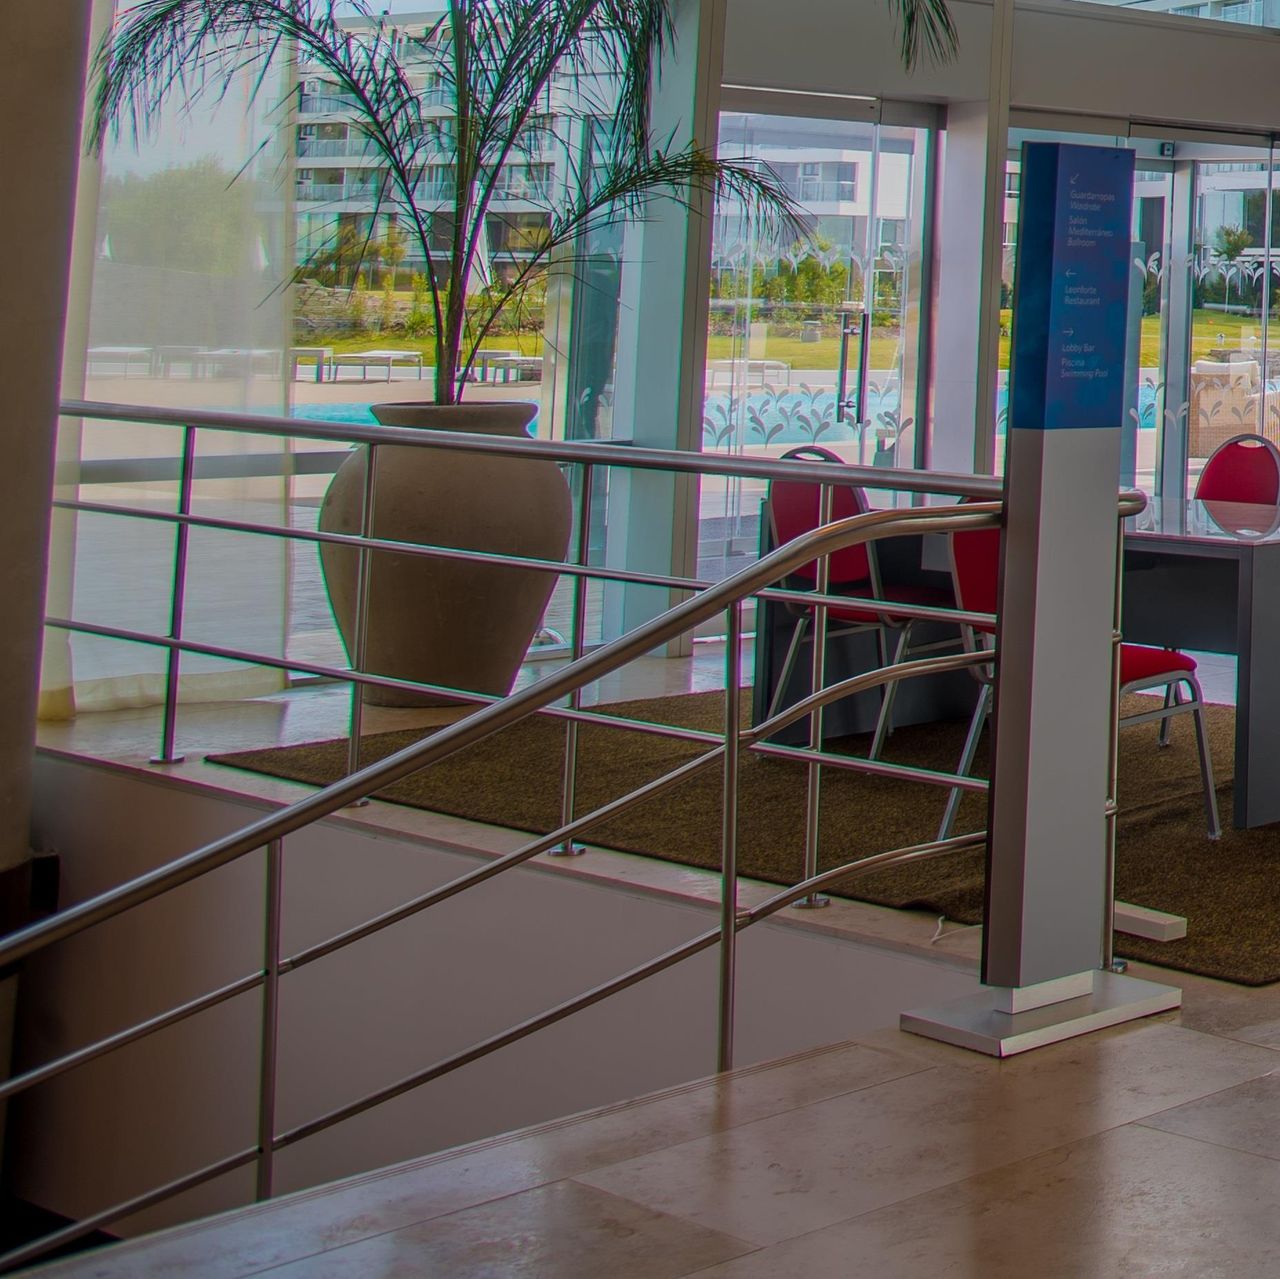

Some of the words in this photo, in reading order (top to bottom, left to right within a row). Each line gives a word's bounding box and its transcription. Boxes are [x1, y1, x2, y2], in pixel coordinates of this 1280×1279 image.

[1064, 295, 1100, 305] Restaurant
[1062, 343, 1082, 354] Lobby
[1083, 343, 1095, 352] Bar
[1061, 358, 1085, 367] Piscina
[1060, 368, 1094, 379] Swimming
[1094, 369, 1109, 378] Pool
